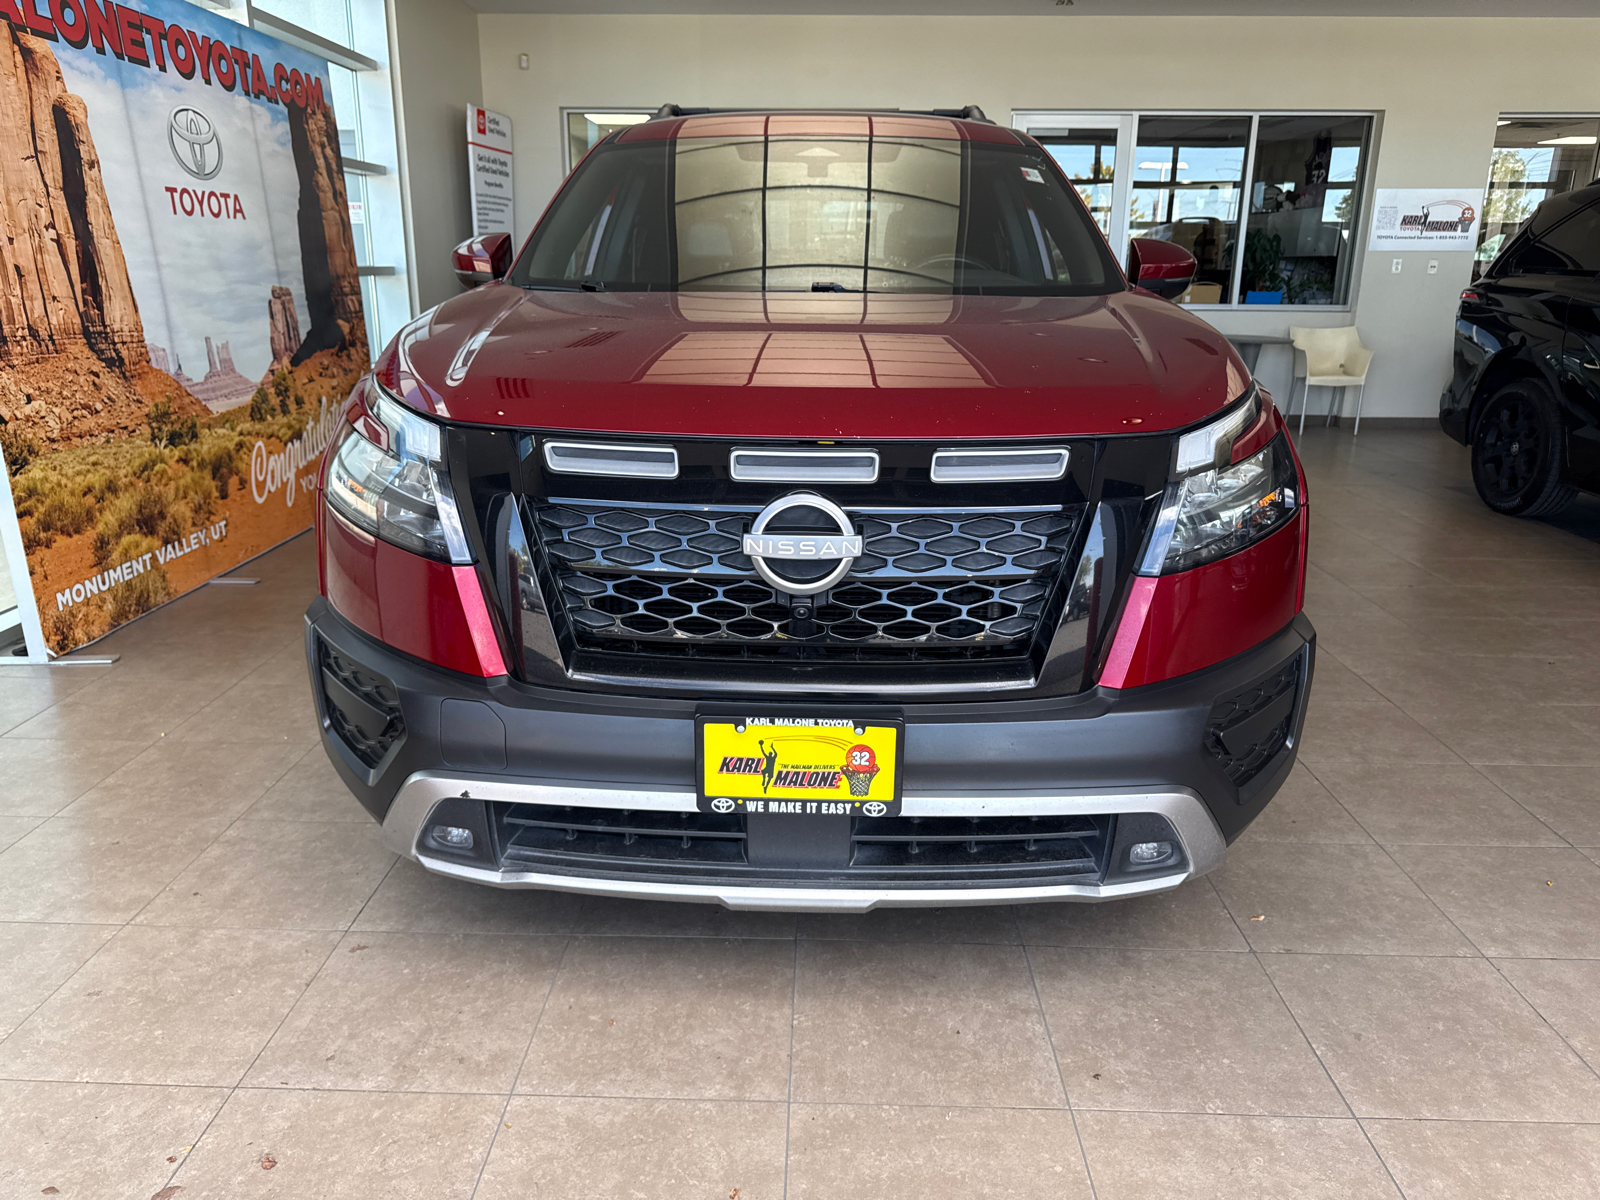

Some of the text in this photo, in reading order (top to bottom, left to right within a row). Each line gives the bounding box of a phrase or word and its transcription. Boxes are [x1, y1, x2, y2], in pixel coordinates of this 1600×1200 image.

[165, 186, 247, 220] TOYOTA
[1463, 209, 1473, 218] 32
[1400, 215, 1460, 232] KARL MALONE
[746, 538, 859, 556] NISSAN
[55, 520, 228, 612] MONUMENT VALLEY, UT
[745, 717, 854, 728] KARL MALONE TOYOTA
[718, 756, 765, 775] KARL
[851, 751, 870, 767] 32
[772, 770, 843, 789] MALONE
[746, 801, 853, 815] WE MAKE IT EASY
